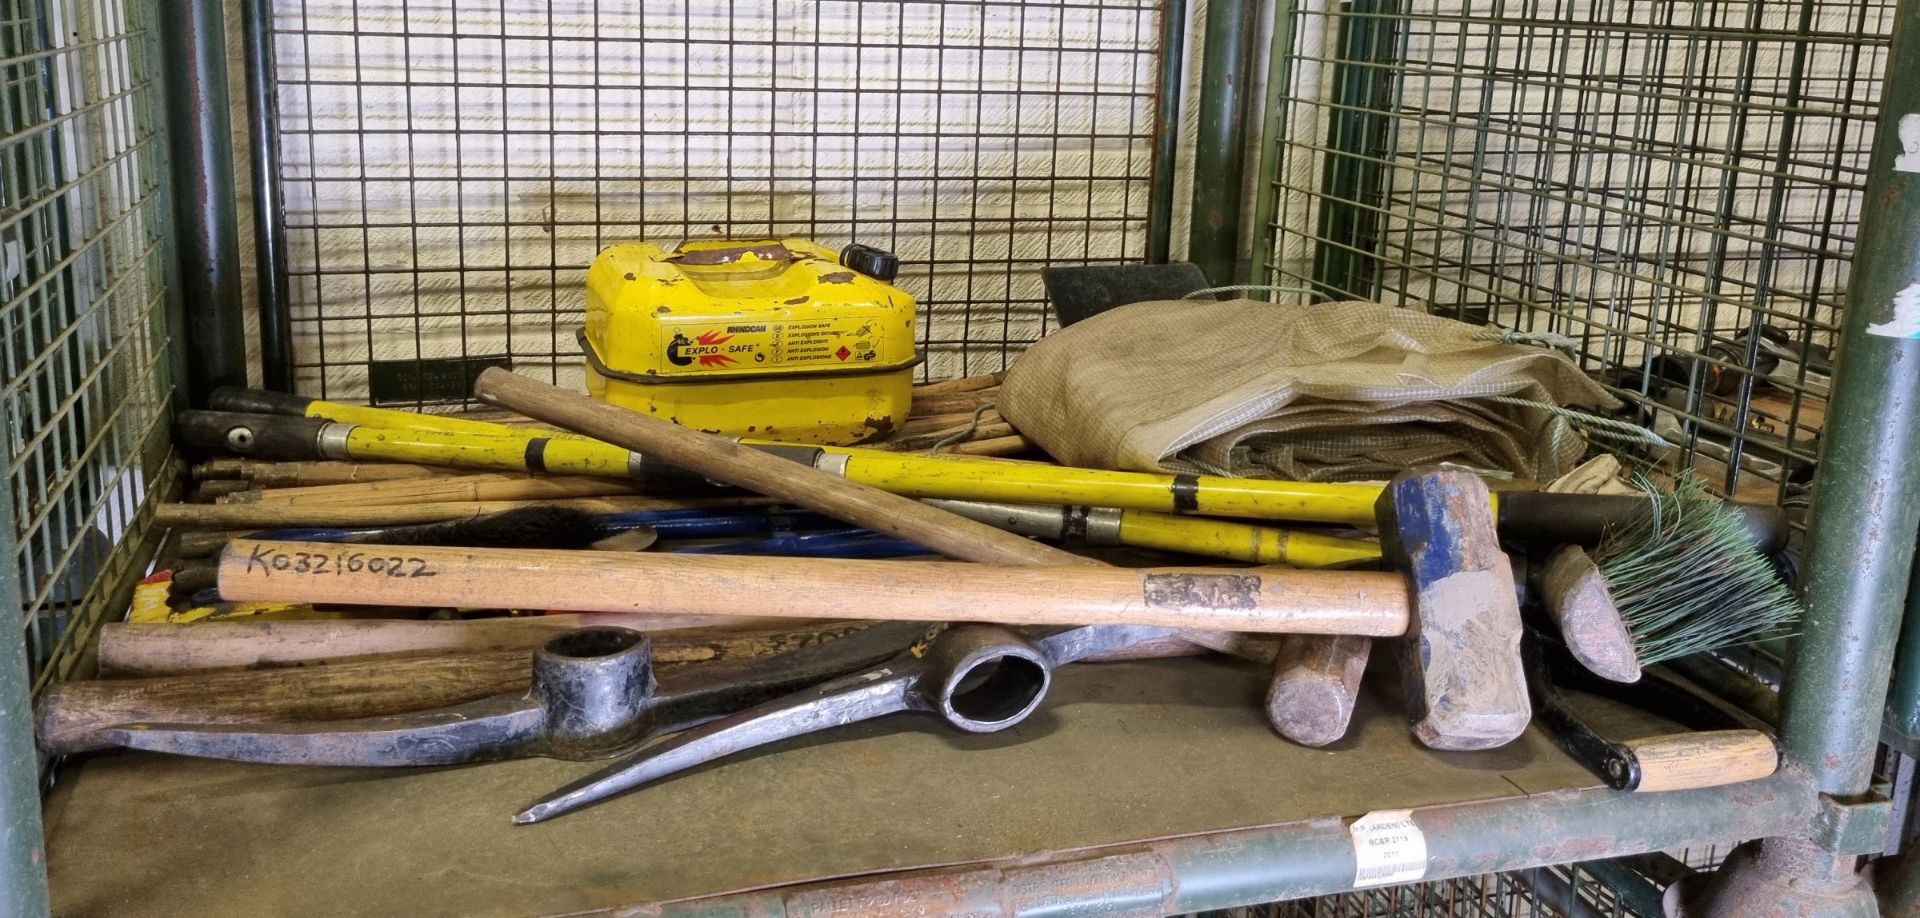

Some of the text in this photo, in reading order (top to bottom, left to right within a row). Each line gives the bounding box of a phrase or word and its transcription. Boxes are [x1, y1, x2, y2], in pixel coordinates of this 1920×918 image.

[685, 346, 718, 355] EXPLO
[247, 544, 437, 577] K03216022
[1369, 822, 1400, 833] (ARDEN)
[1368, 837, 1391, 846] BC&R
